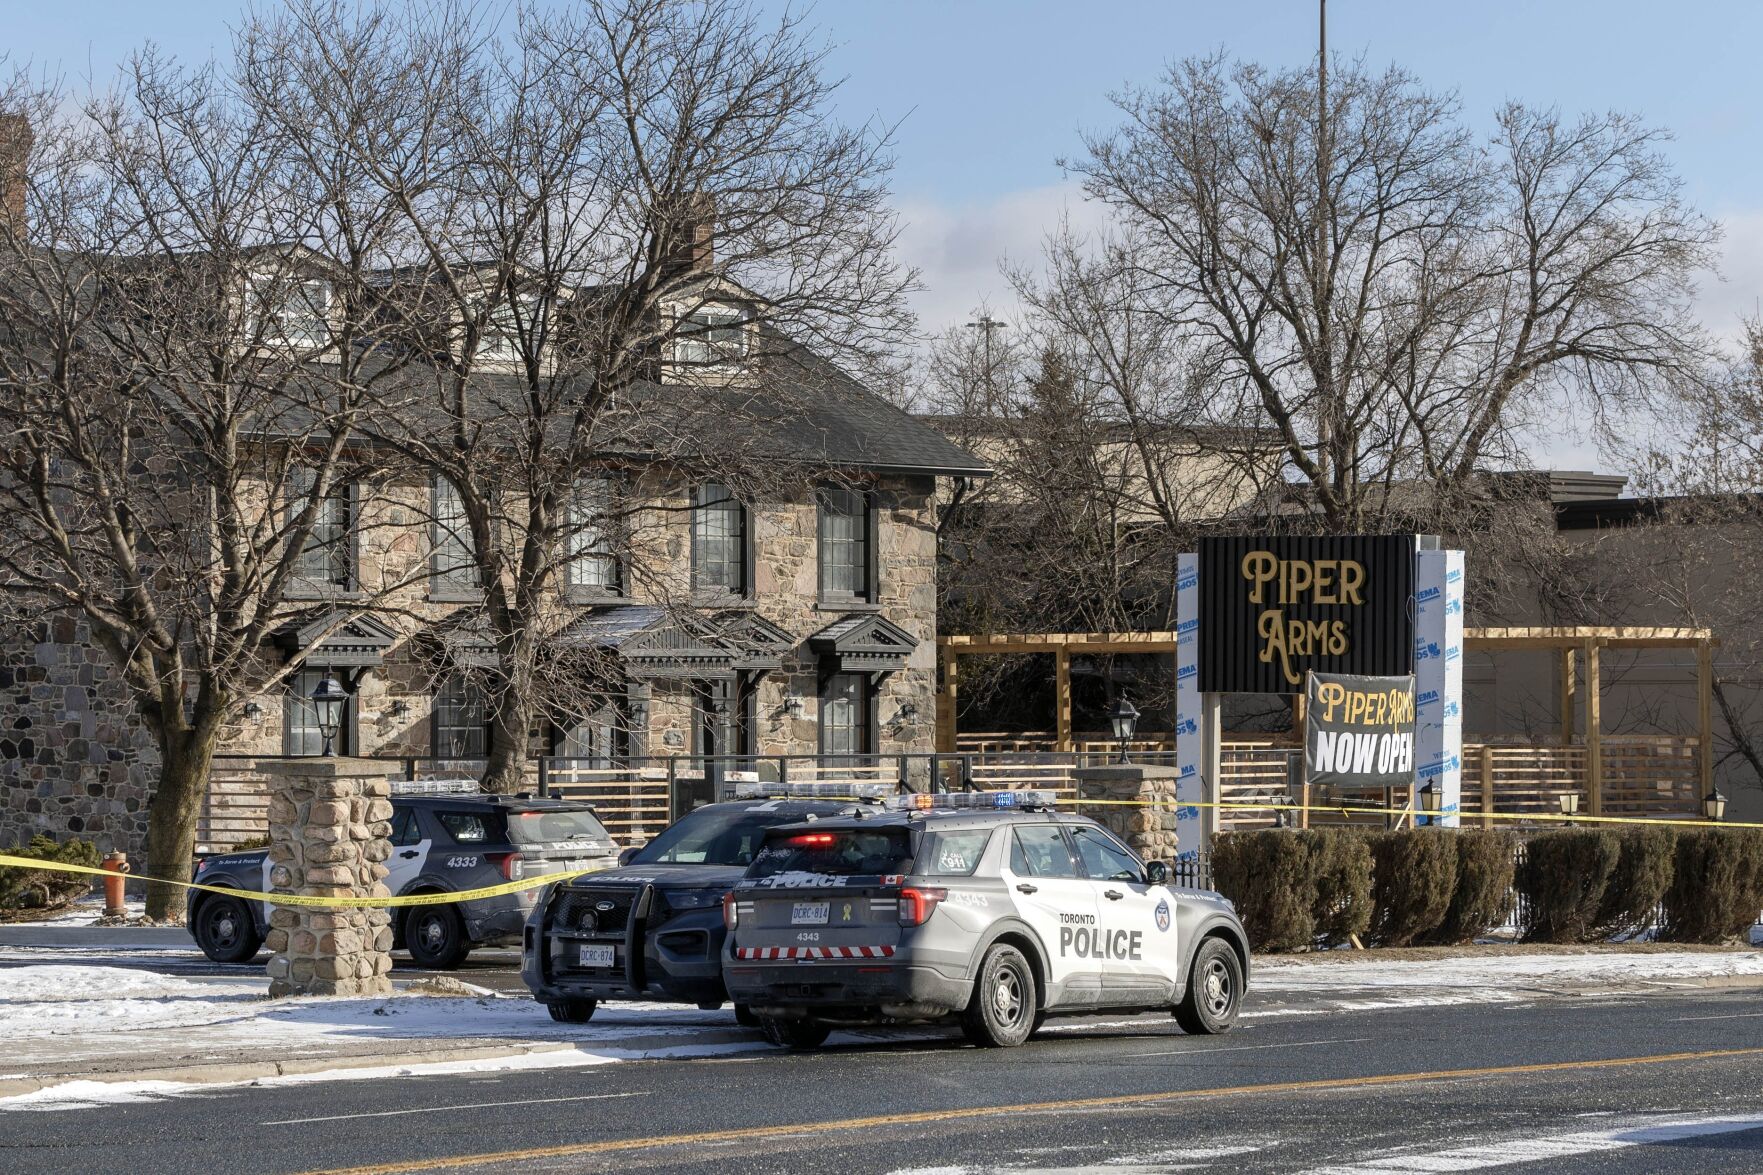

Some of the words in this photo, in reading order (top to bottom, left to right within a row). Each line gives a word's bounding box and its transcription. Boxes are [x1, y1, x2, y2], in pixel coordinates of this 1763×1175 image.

[1242, 551, 1367, 605] PIPER
[1258, 609, 1349, 685] ARMS
[1318, 683, 1387, 725] PIPER
[1315, 730, 1377, 773] NOW
[1377, 732, 1413, 773] OPEN
[552, 841, 599, 850] POLICE
[448, 857, 477, 868] 4333
[956, 893, 988, 907] 4343
[1060, 913, 1095, 925] TORONTO
[797, 933, 819, 942] 4343
[1060, 927, 1142, 961] POLICE
